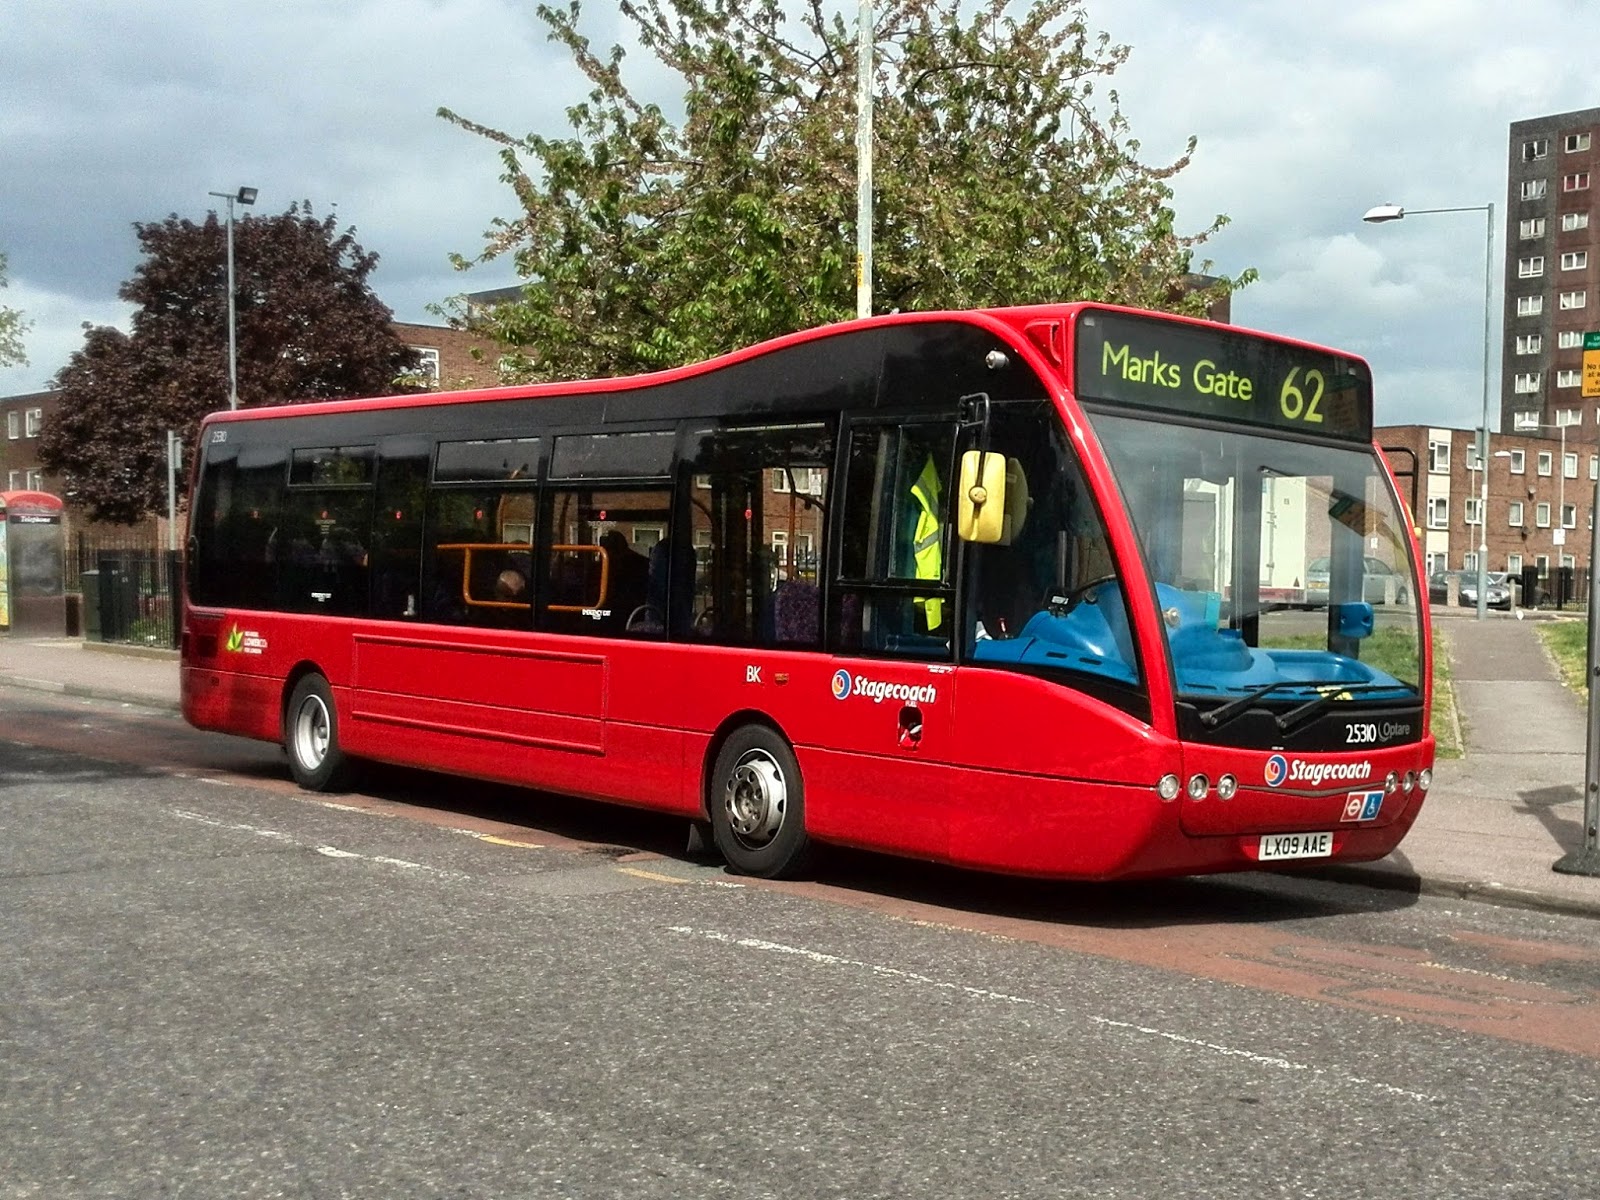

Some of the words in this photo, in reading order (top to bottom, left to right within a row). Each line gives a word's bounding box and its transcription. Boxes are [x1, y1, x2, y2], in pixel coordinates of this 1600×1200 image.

[1102, 341, 1181, 388] Marks
[1193, 359, 1252, 401] Gate
[1280, 366, 1325, 423] 62
[746, 665, 762, 683] BK
[852, 675, 937, 704] Stagecoach
[1345, 723, 1377, 743] 25310
[1383, 722, 1411, 739] Optare
[1288, 759, 1372, 785] Stagecoach
[1264, 836, 1299, 857] LX09
[1302, 835, 1329, 854] AAE
